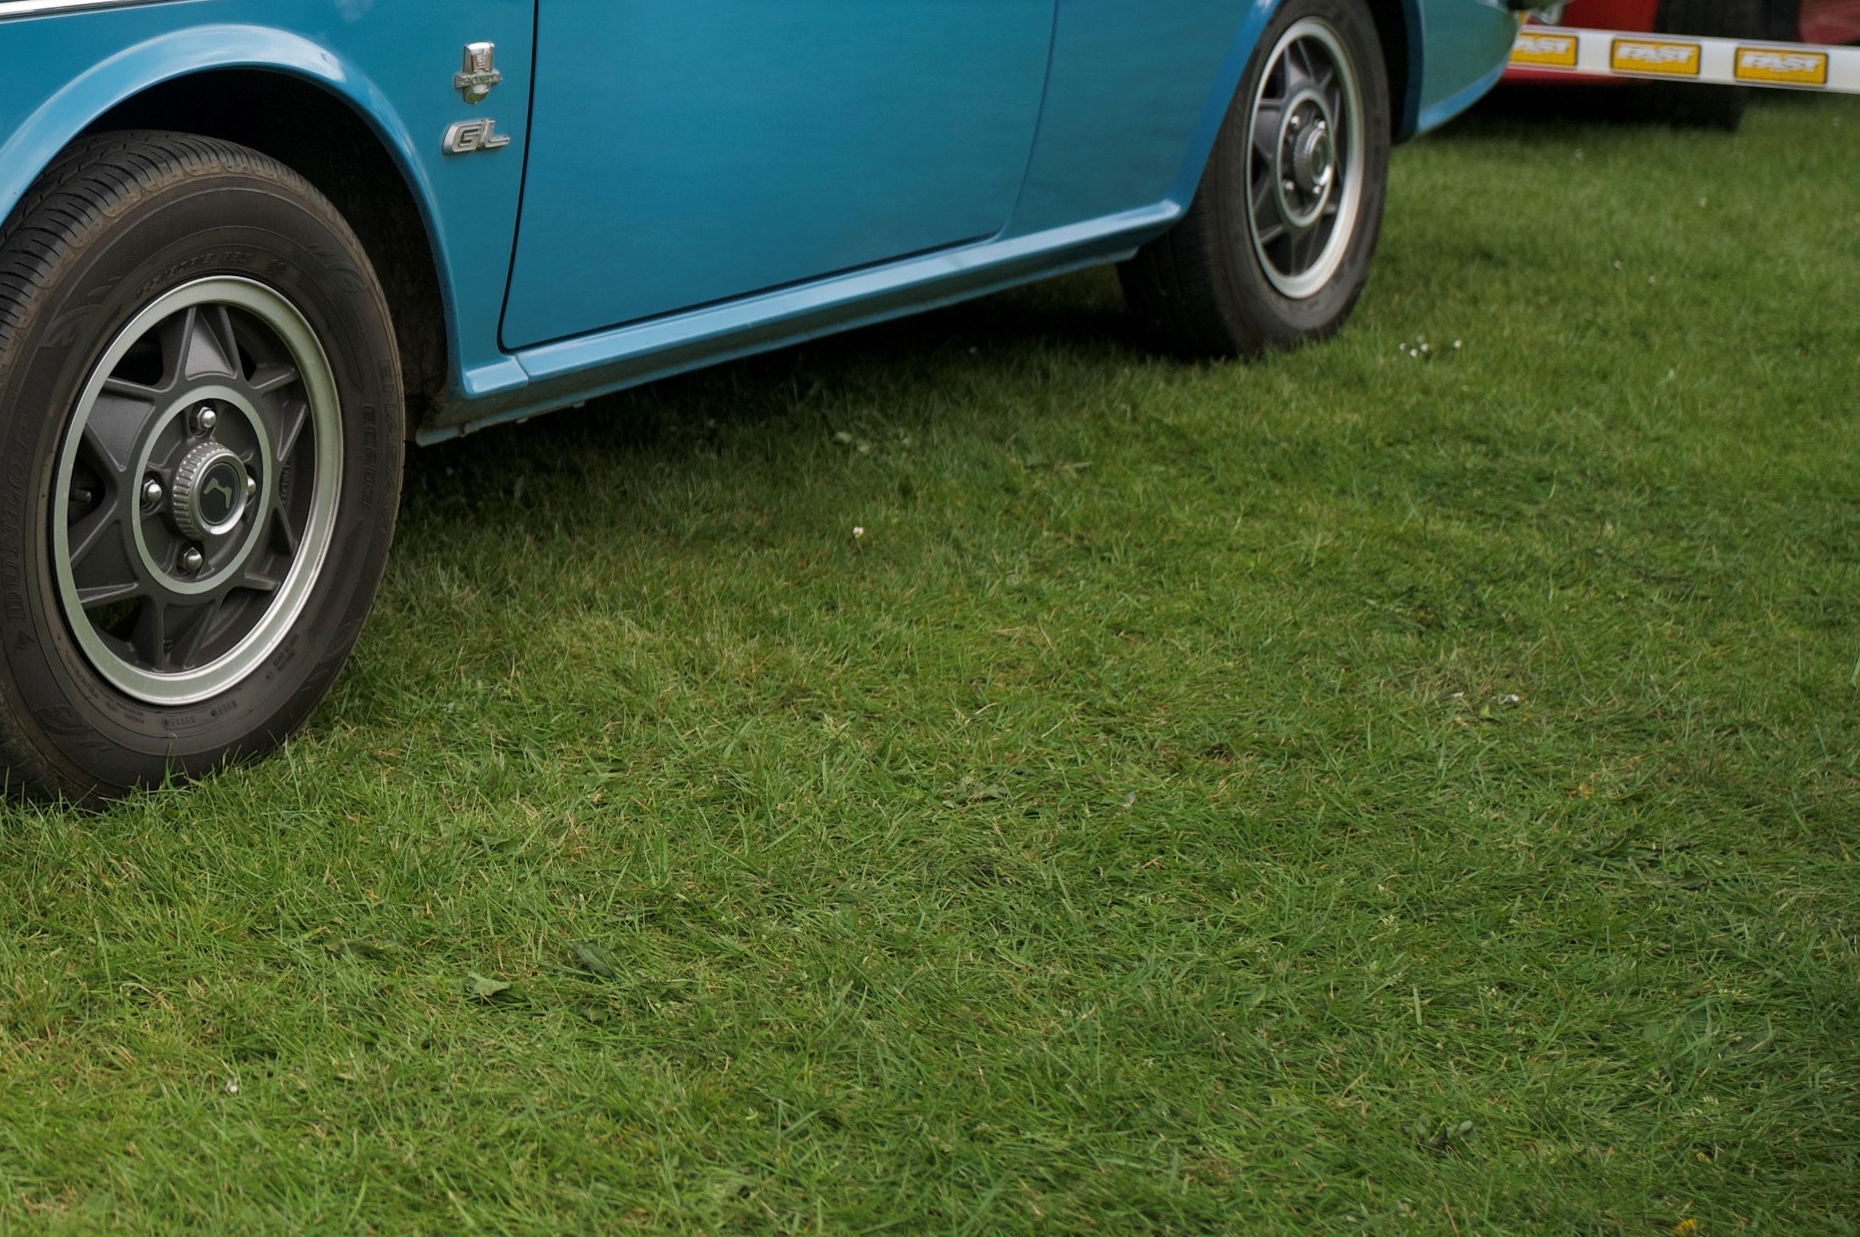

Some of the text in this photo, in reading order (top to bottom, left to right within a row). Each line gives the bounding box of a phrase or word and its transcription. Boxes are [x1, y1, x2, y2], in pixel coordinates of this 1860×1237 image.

[1616, 43, 1693, 64] FAST
[1740, 51, 1820, 73] FAST
[443, 118, 510, 155] GL
